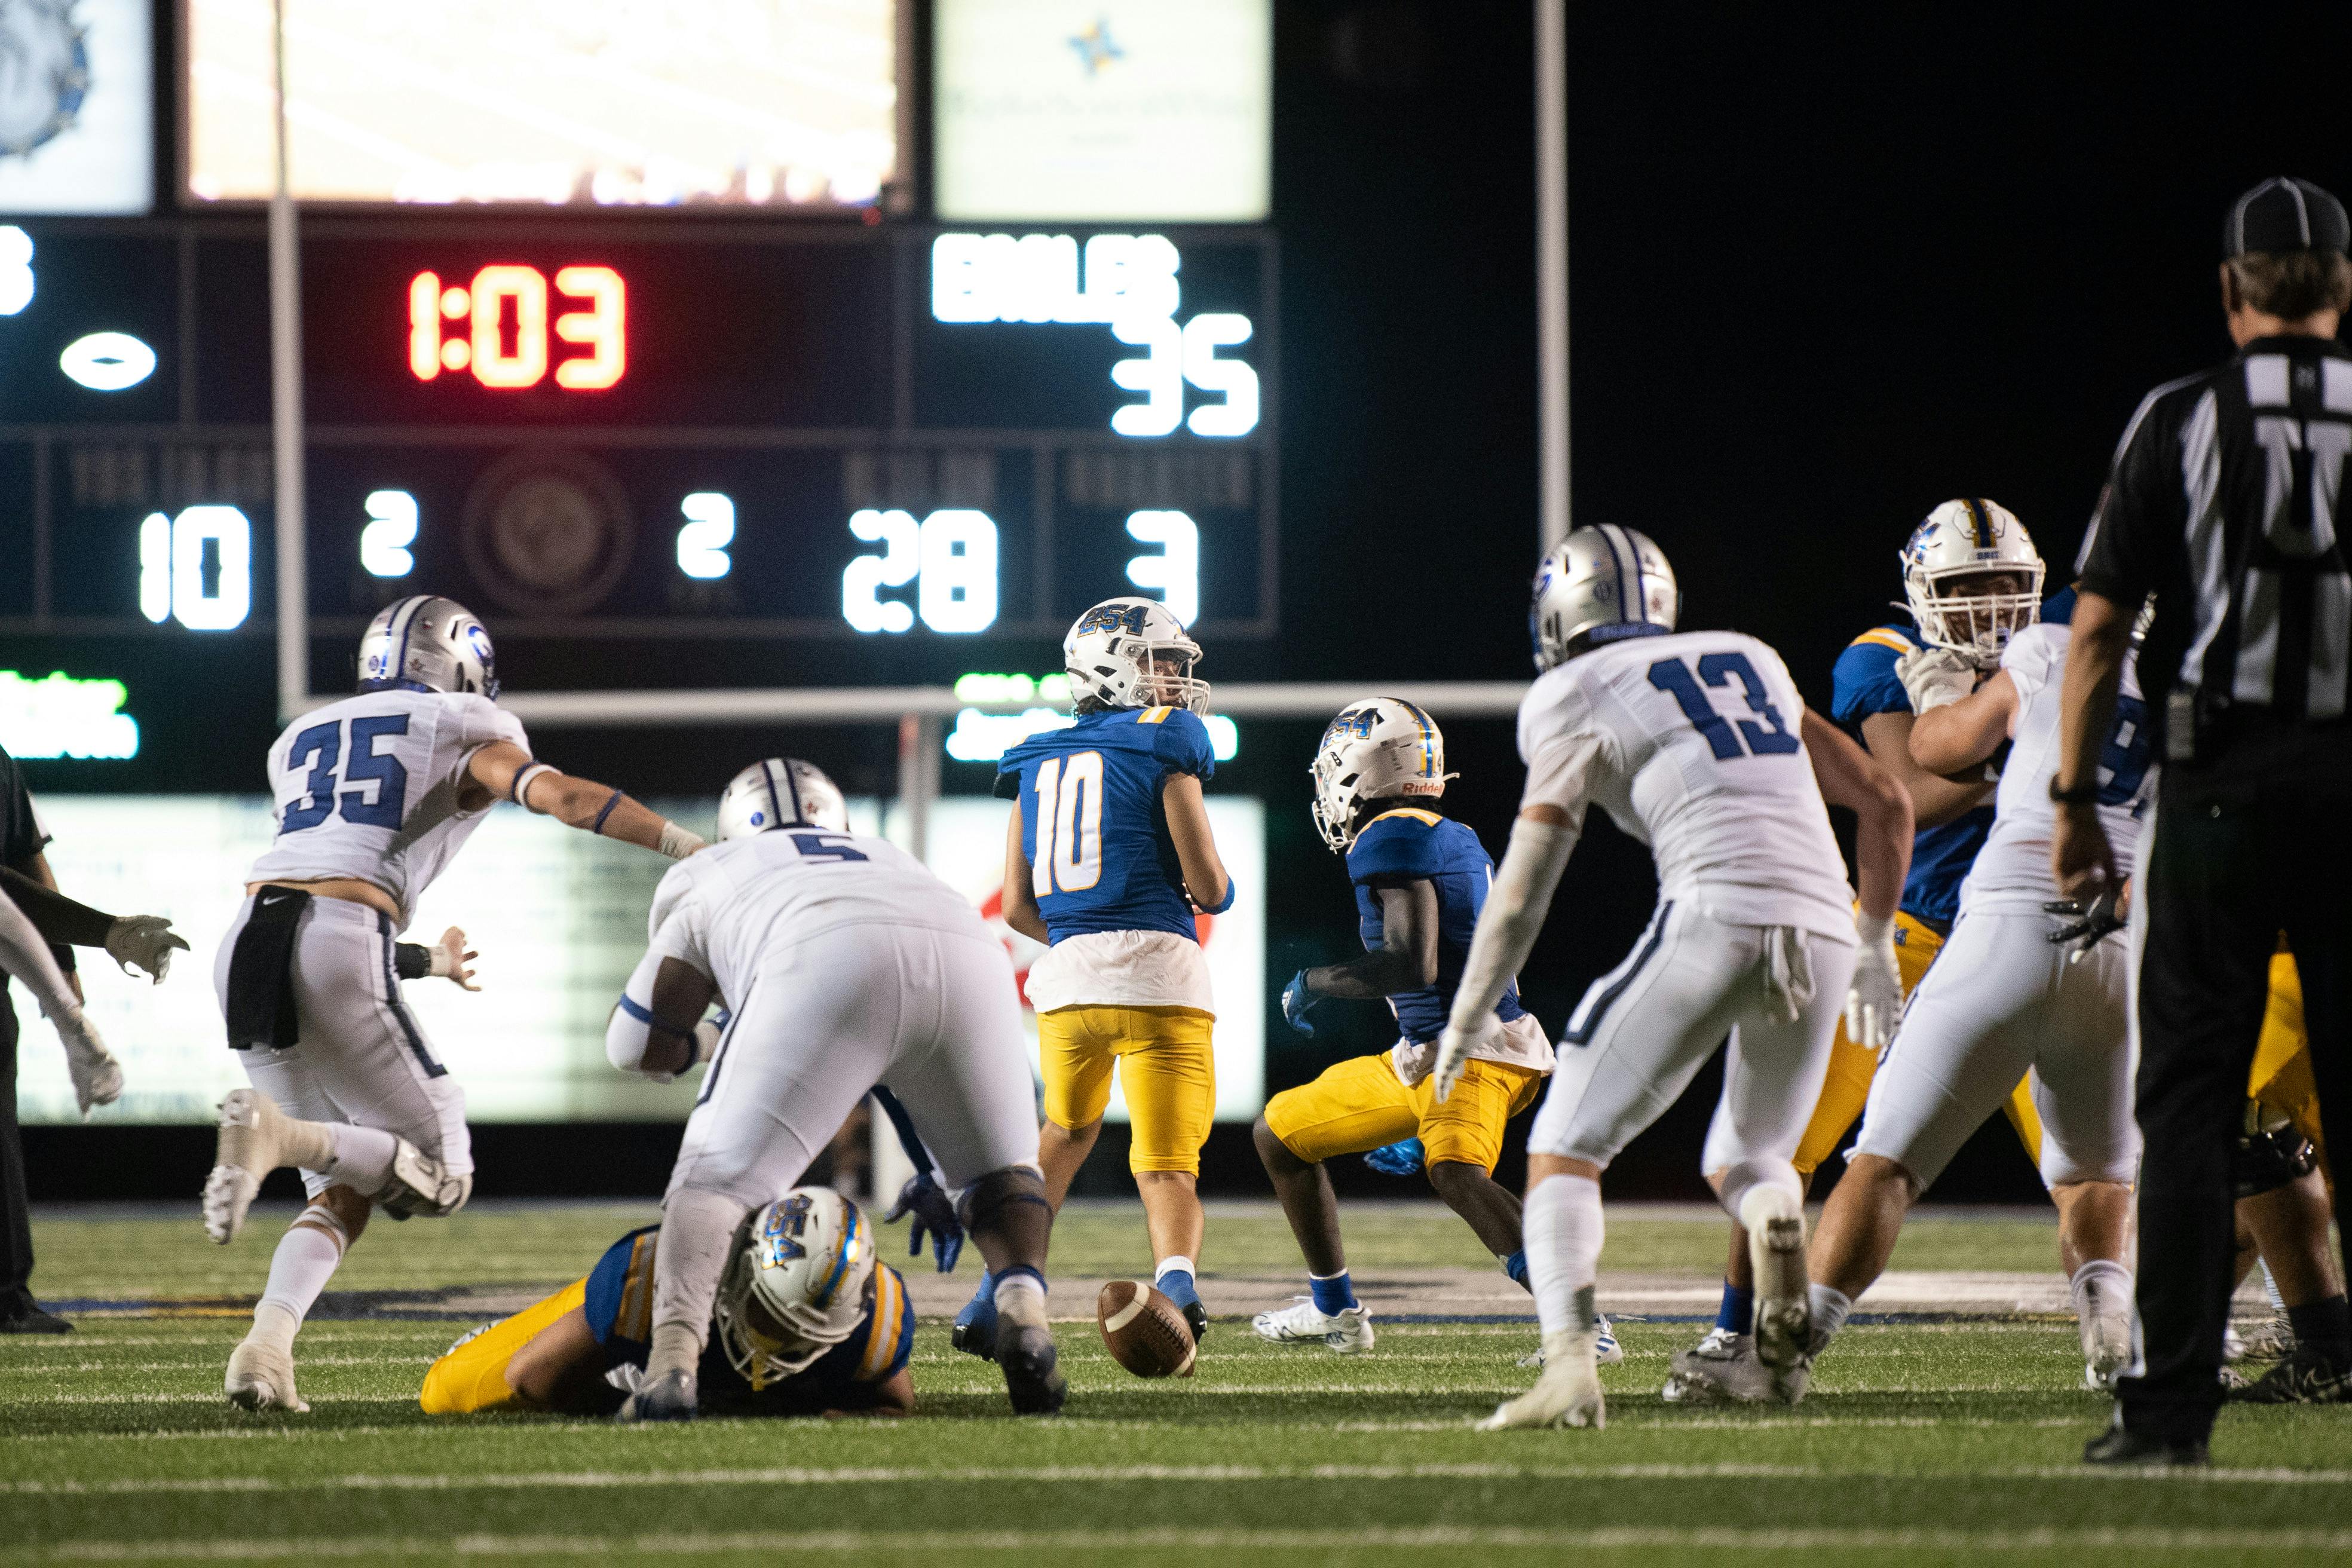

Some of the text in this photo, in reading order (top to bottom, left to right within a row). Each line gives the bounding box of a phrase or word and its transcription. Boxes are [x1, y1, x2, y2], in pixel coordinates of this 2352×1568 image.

[409, 264, 627, 390] 1:03
[1110, 313, 1258, 436] 35
[140, 506, 249, 630] 10
[362, 491, 418, 577] 2
[677, 492, 735, 578] 2
[842, 509, 997, 632] 28
[1126, 510, 1199, 633] 3
[1077, 604, 1149, 638] 254
[1647, 652, 1800, 760] 13
[280, 714, 411, 835] 35
[1033, 751, 1104, 898] 10
